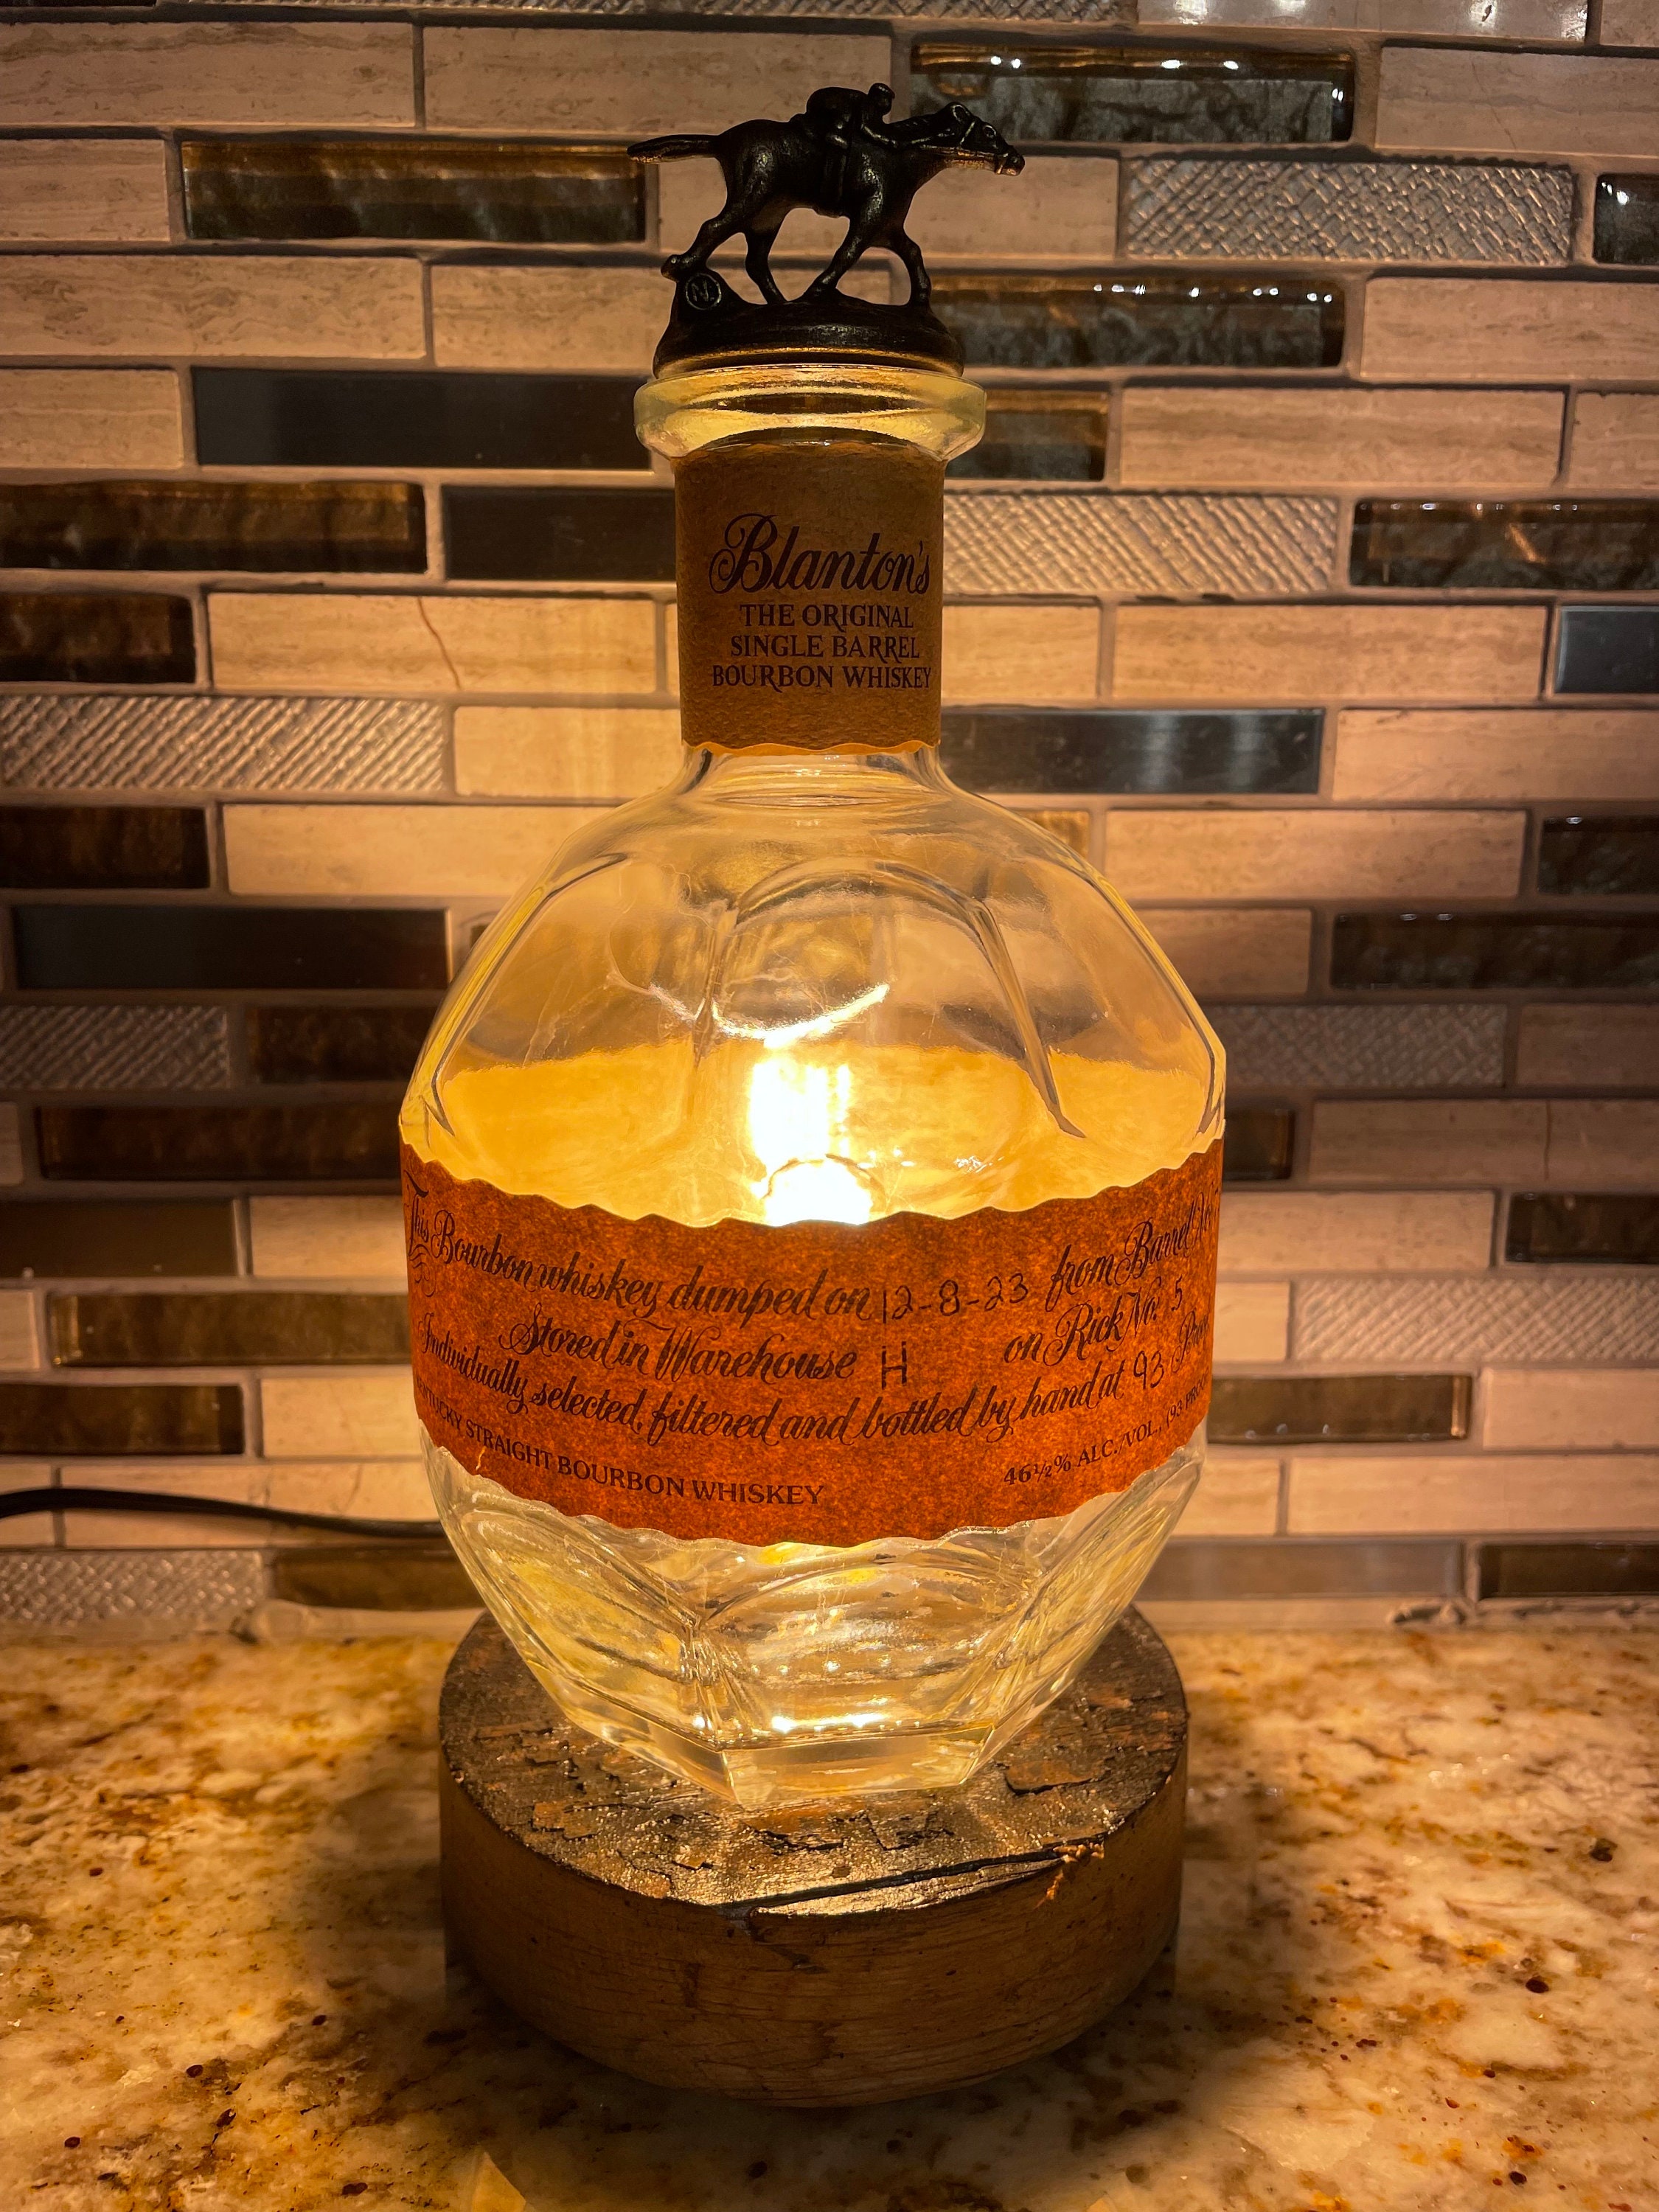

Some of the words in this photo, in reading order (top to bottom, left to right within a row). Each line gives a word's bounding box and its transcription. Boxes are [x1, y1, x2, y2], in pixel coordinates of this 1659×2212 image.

[709, 513, 931, 594] Blanton's
[740, 604, 795, 627] THE
[802, 605, 914, 633] ORIGINAL
[731, 635, 824, 658] SINGLE
[832, 636, 920, 664] BARREL
[712, 665, 834, 693] BOURBON
[842, 666, 931, 689] WHISKEY
[431, 1210, 535, 1292] Bourbon
[536, 1251, 661, 1318] whiskey
[667, 1265, 828, 1329] dumped
[825, 1286, 872, 1321] on
[882, 1273, 1029, 1324] 12-8-23
[1046, 1245, 1114, 1312] from
[1114, 1200, 1194, 1285] Barrel
[1171, 1274, 1183, 1311] 5
[498, 1302, 621, 1371] Stored
[614, 1330, 649, 1374] in
[624, 1318, 858, 1385] Warehouse
[1004, 1332, 1043, 1363] on
[1043, 1295, 1124, 1366] Rick
[418, 1312, 529, 1414] Individually
[647, 1391, 783, 1446] filtered
[779, 1397, 860, 1446] and
[854, 1384, 979, 1439] bottled
[971, 1385, 1016, 1443] by
[1012, 1362, 1102, 1422] hand
[1098, 1360, 1124, 1399] at
[1133, 1350, 1165, 1389] 93
[881, 1340, 908, 1390] H
[466, 1419, 552, 1470] STRAIGHT
[557, 1455, 685, 1498] BOURBON
[692, 1480, 824, 1505] WHISKEY
